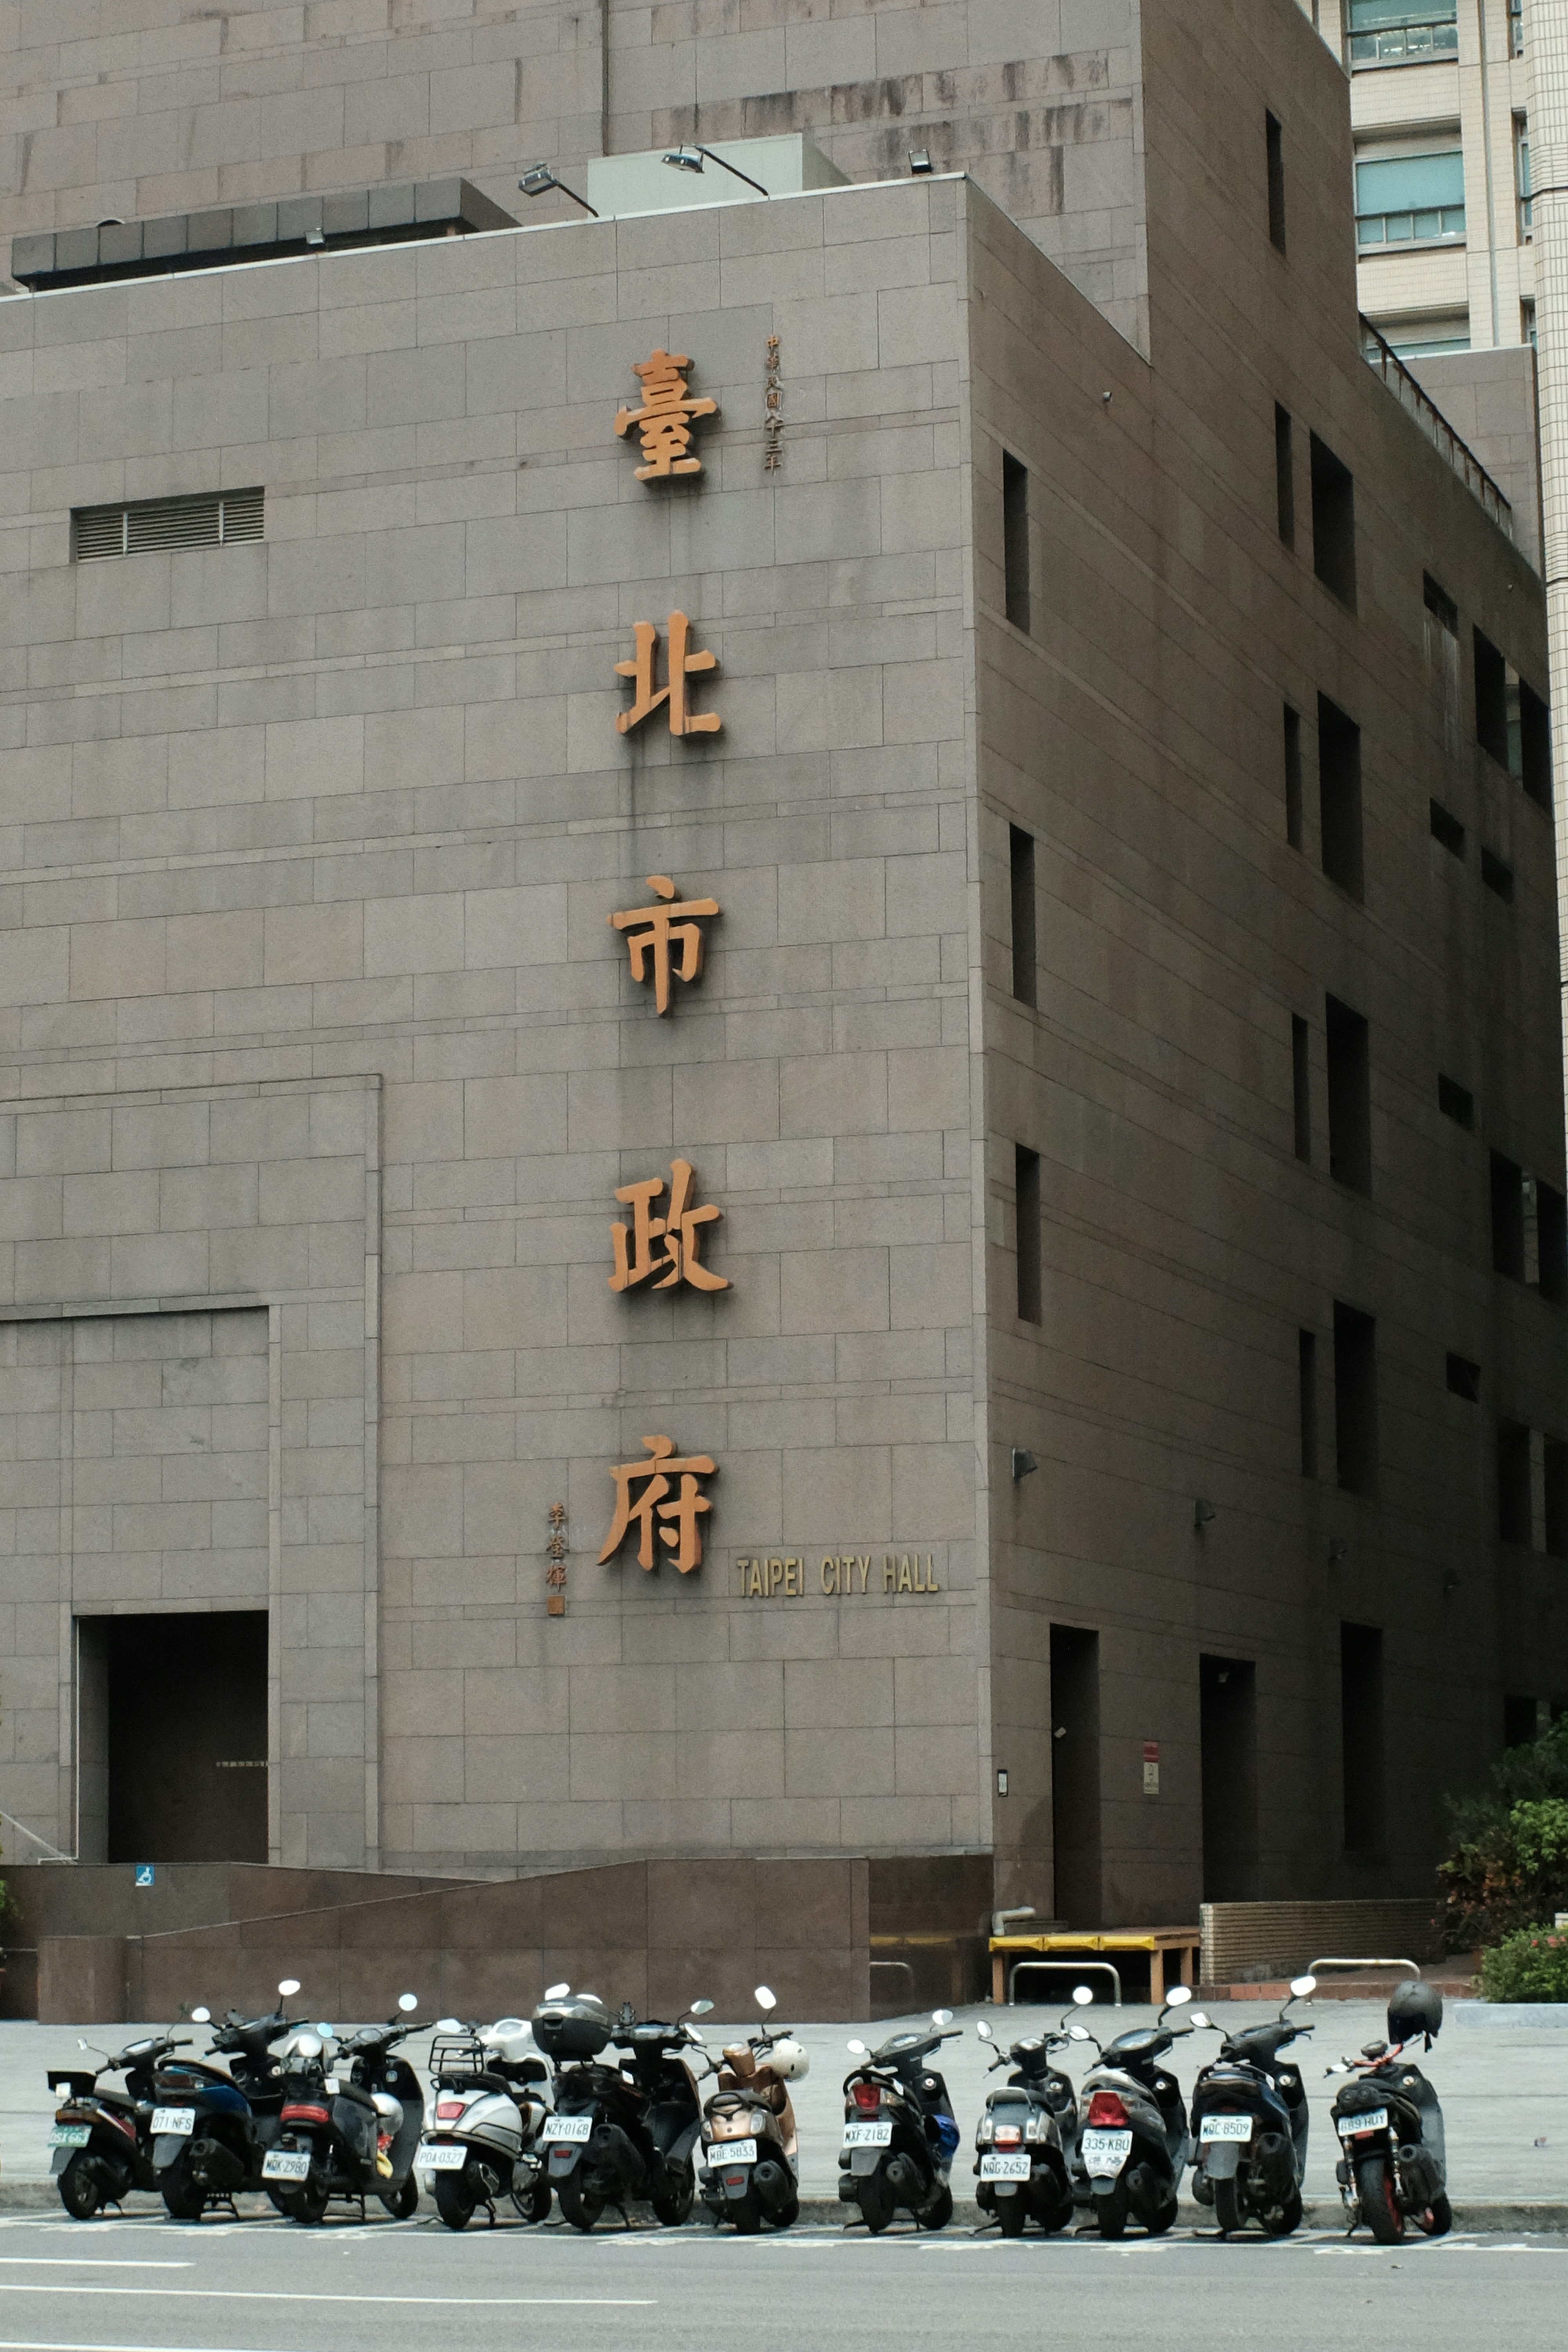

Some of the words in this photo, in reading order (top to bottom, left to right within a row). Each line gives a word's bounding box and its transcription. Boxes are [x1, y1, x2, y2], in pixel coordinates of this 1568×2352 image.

[764, 335, 783, 476] 中華民國八十三年
[598, 348, 730, 1573] 臺北市政府
[546, 1503, 569, 1592] 李登輝
[737, 1557, 804, 1597] TAIPEI
[821, 1555, 871, 1595] CITY
[882, 1553, 939, 1593] HALL
